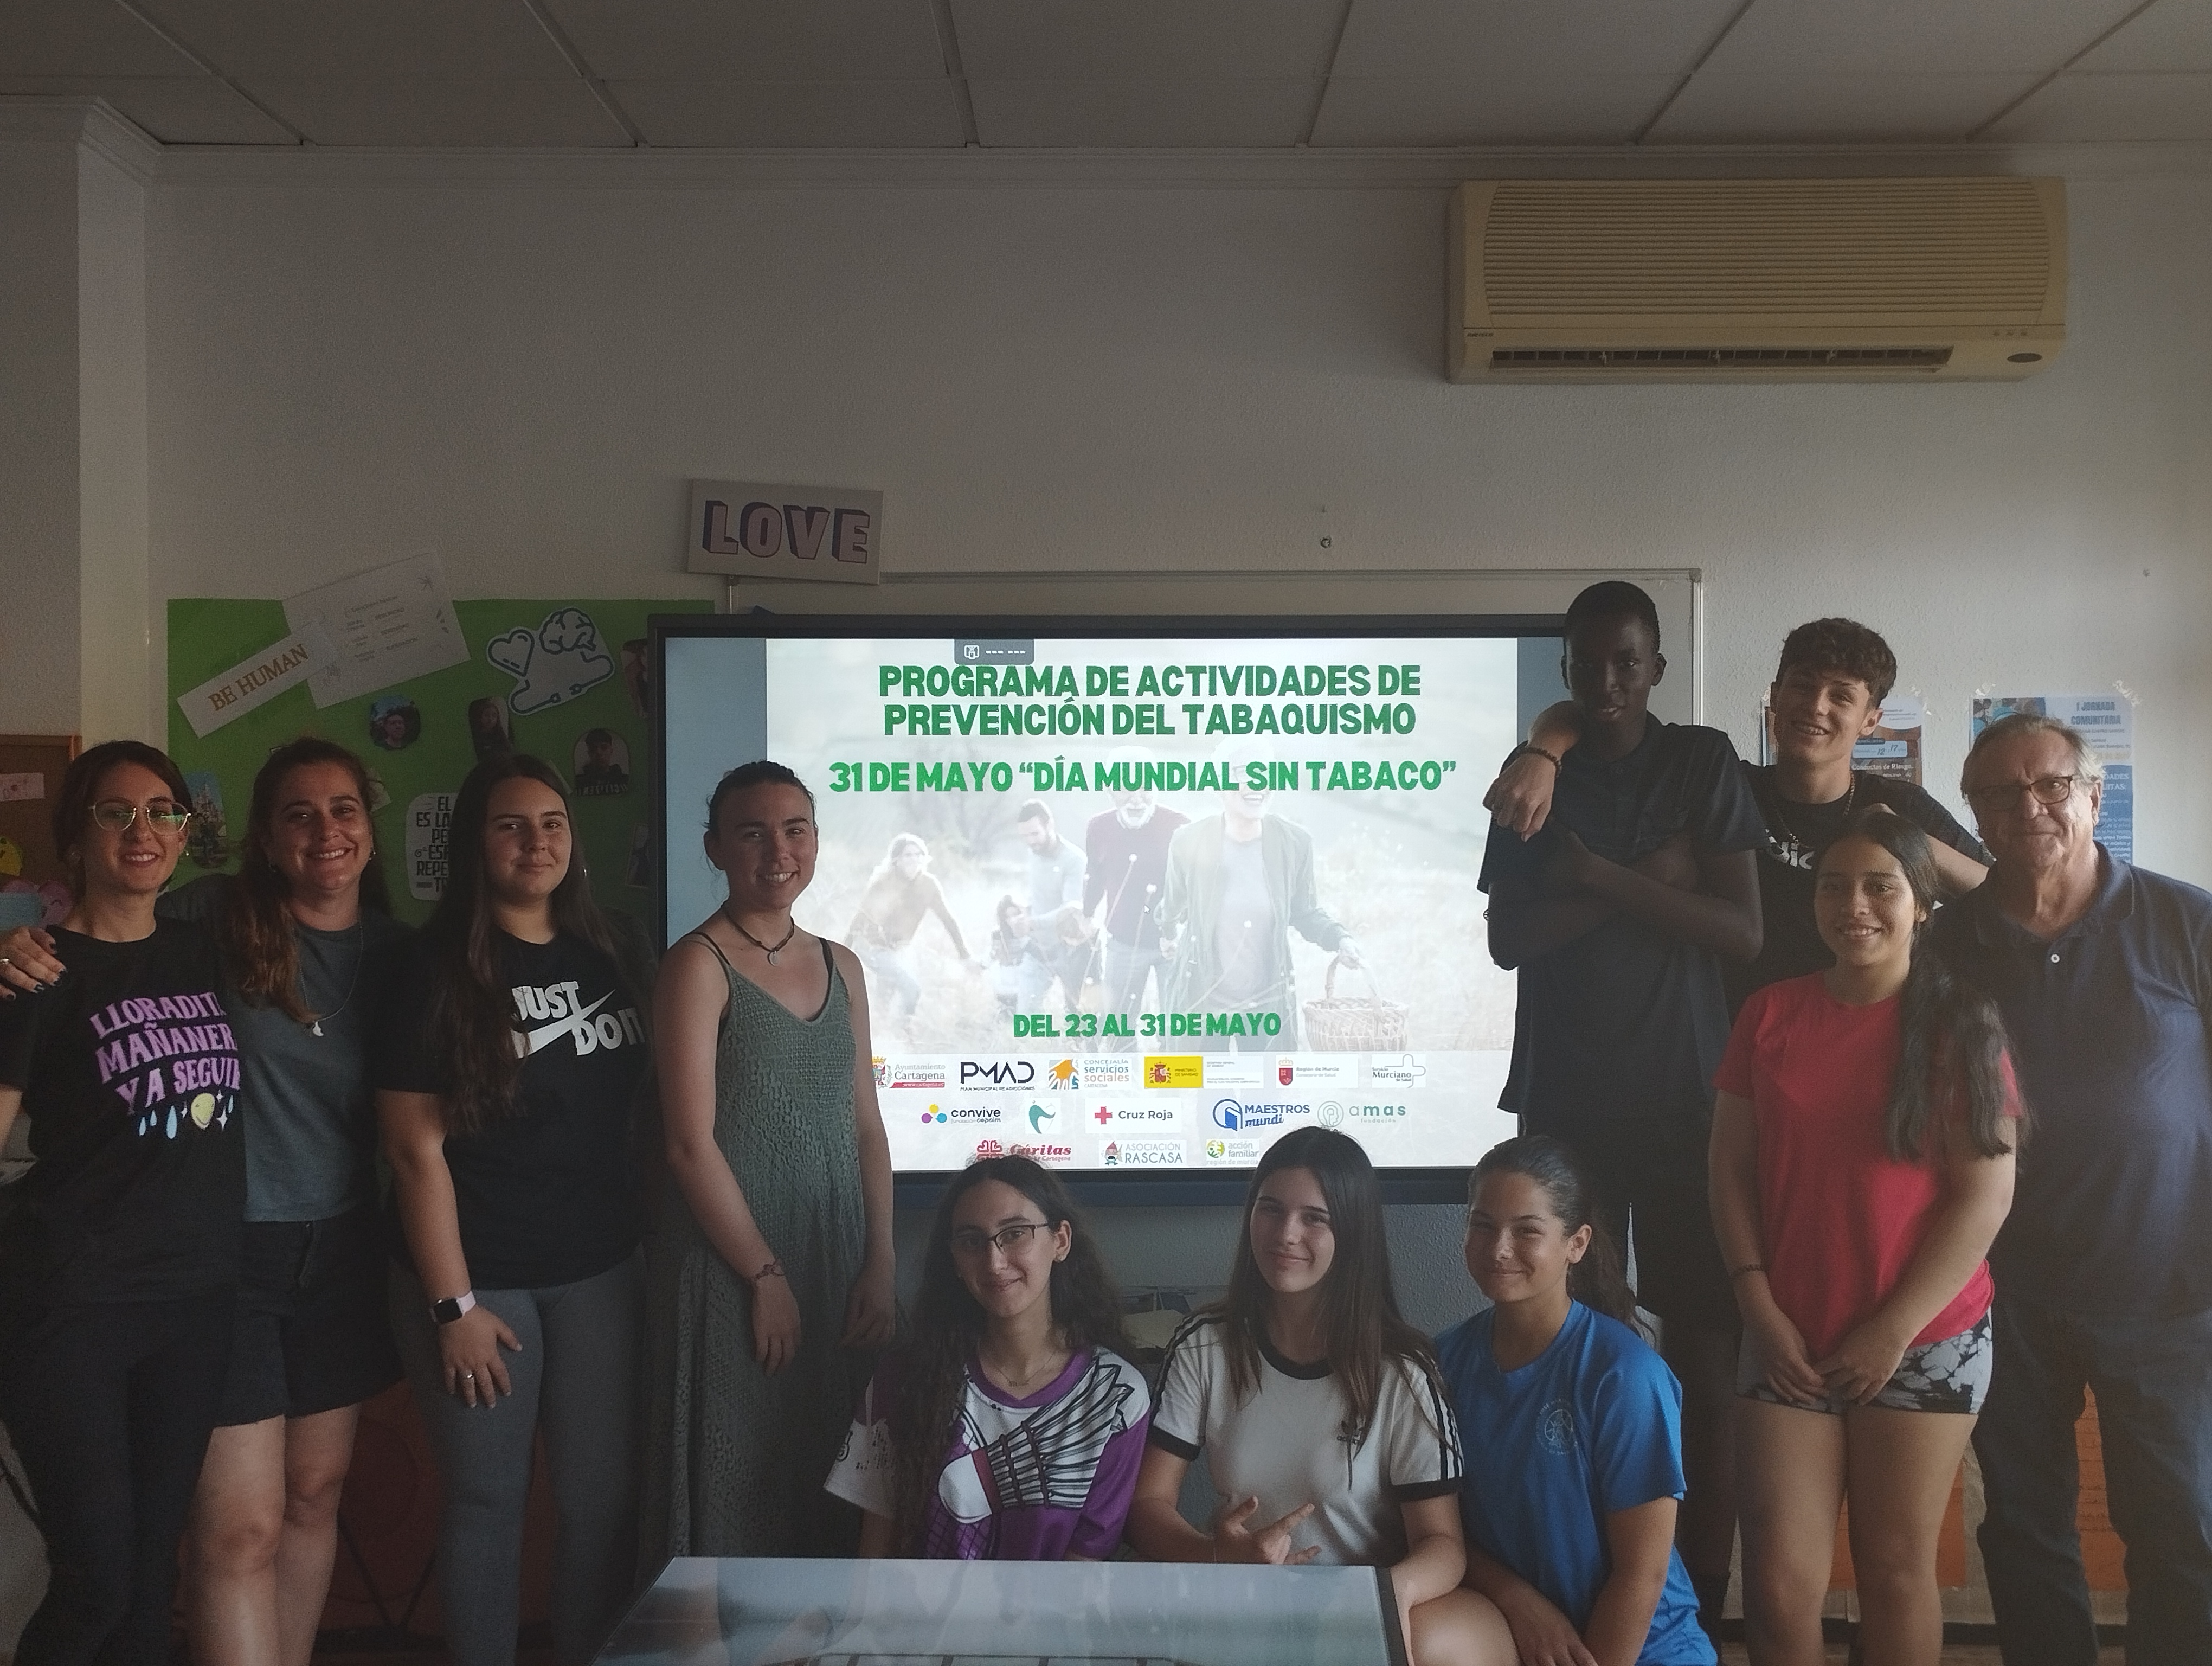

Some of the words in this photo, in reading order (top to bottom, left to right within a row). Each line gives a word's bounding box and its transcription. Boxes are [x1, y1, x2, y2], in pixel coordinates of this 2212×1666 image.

[702, 501, 870, 563] LOVE
[208, 685, 238, 711] BE
[235, 644, 308, 696] HUMAN
[879, 665, 1079, 697] PROGRAMA
[1086, 665, 1129, 696] DE
[1136, 665, 1371, 696] ACTIVIDADES
[1378, 665, 1421, 696] DE
[2081, 702, 2115, 711] JORNADA
[884, 697, 1105, 735] PREVENCIÓN
[1113, 704, 1175, 735] DEL
[1182, 703, 1416, 734] TABAQUISMO
[2070, 715, 2121, 725] COMUNITARIA
[829, 762, 863, 792] 31
[869, 762, 910, 792] DE
[917, 762, 1013, 792] MAYO
[1095, 761, 1240, 792] MUNDIAL
[1246, 761, 1299, 791] SIN
[1306, 760, 1457, 791] TABACO”
[417, 812, 431, 827] ES
[512, 980, 579, 1021] JUST
[1013, 1014, 1060, 1037] DEL
[1065, 1014, 1098, 1037] 23
[1102, 1013, 1135, 1037] AL
[1140, 1013, 1165, 1037] 31
[1170, 1013, 1202, 1036] DE
[1206, 1013, 1282, 1036] MAYO
[895, 1063, 946, 1072] Ayuntamiento
[961, 1061, 1035, 1084] PMAD
[895, 1071, 945, 1081] Cartagena
[1084, 1072, 1129, 1082] sociales
[951, 1106, 1001, 1117] convive
[1245, 1105, 1310, 1113] MAESTROS
[1349, 1105, 1406, 1116] amas
[1118, 1111, 1144, 1119] Cruz
[1148, 1110, 1173, 1120] Roja
[1245, 1114, 1284, 1127] mundi
[1009, 1144, 1071, 1155] Cáritas
[1126, 1142, 1181, 1151] ASOCIACIÓN
[1124, 1152, 1183, 1163] RASCASA
